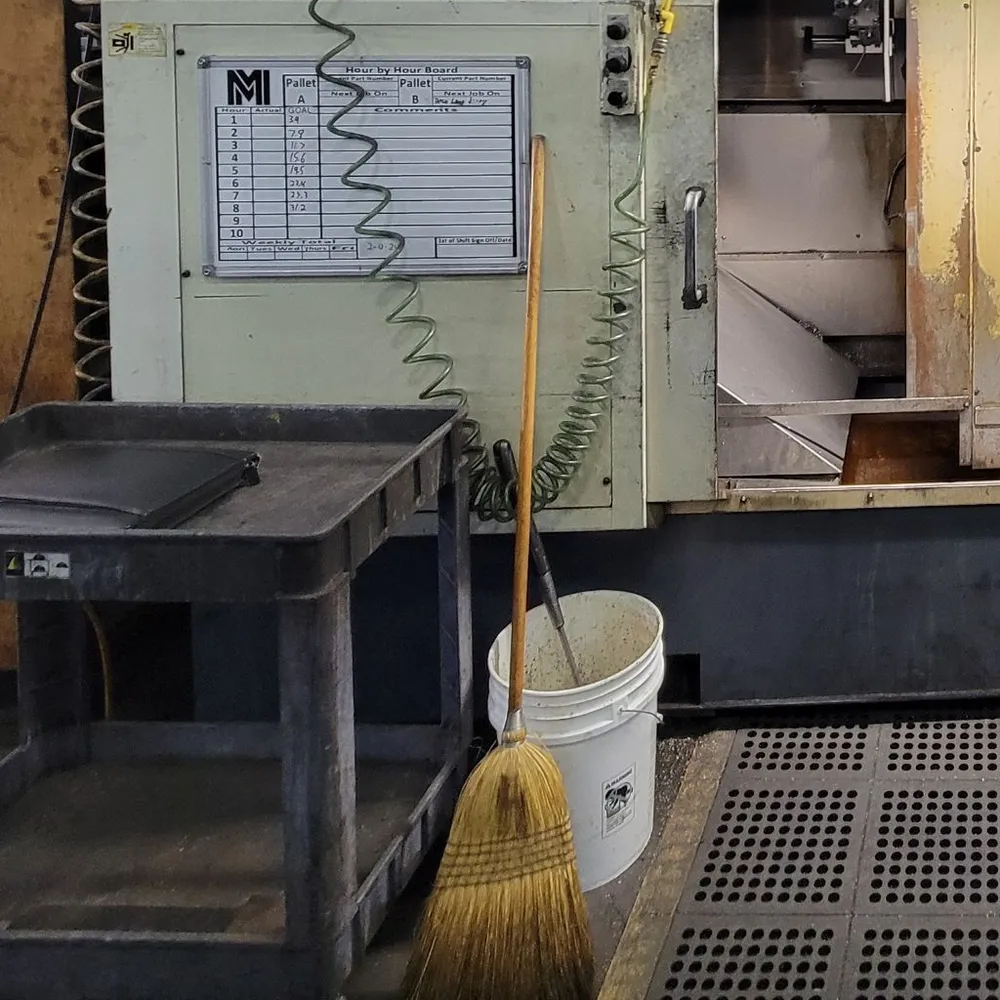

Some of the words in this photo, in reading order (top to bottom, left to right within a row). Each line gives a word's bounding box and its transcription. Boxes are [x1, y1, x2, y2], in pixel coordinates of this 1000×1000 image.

[377, 67, 390, 75] by
[286, 78, 316, 88] Pallet
[400, 78, 431, 88] Pallet
[297, 95, 306, 104] A
[412, 95, 419, 104] B
[231, 115, 237, 124] 1
[231, 128, 238, 137] 2
[231, 141, 238, 150] 3
[231, 153, 238, 162] 4
[232, 166, 239, 175] 5
[232, 179, 239, 188] 6
[232, 191, 239, 200] 7
[232, 204, 240, 213] 8
[233, 216, 240, 225] 9
[230, 229, 243, 238] 10
